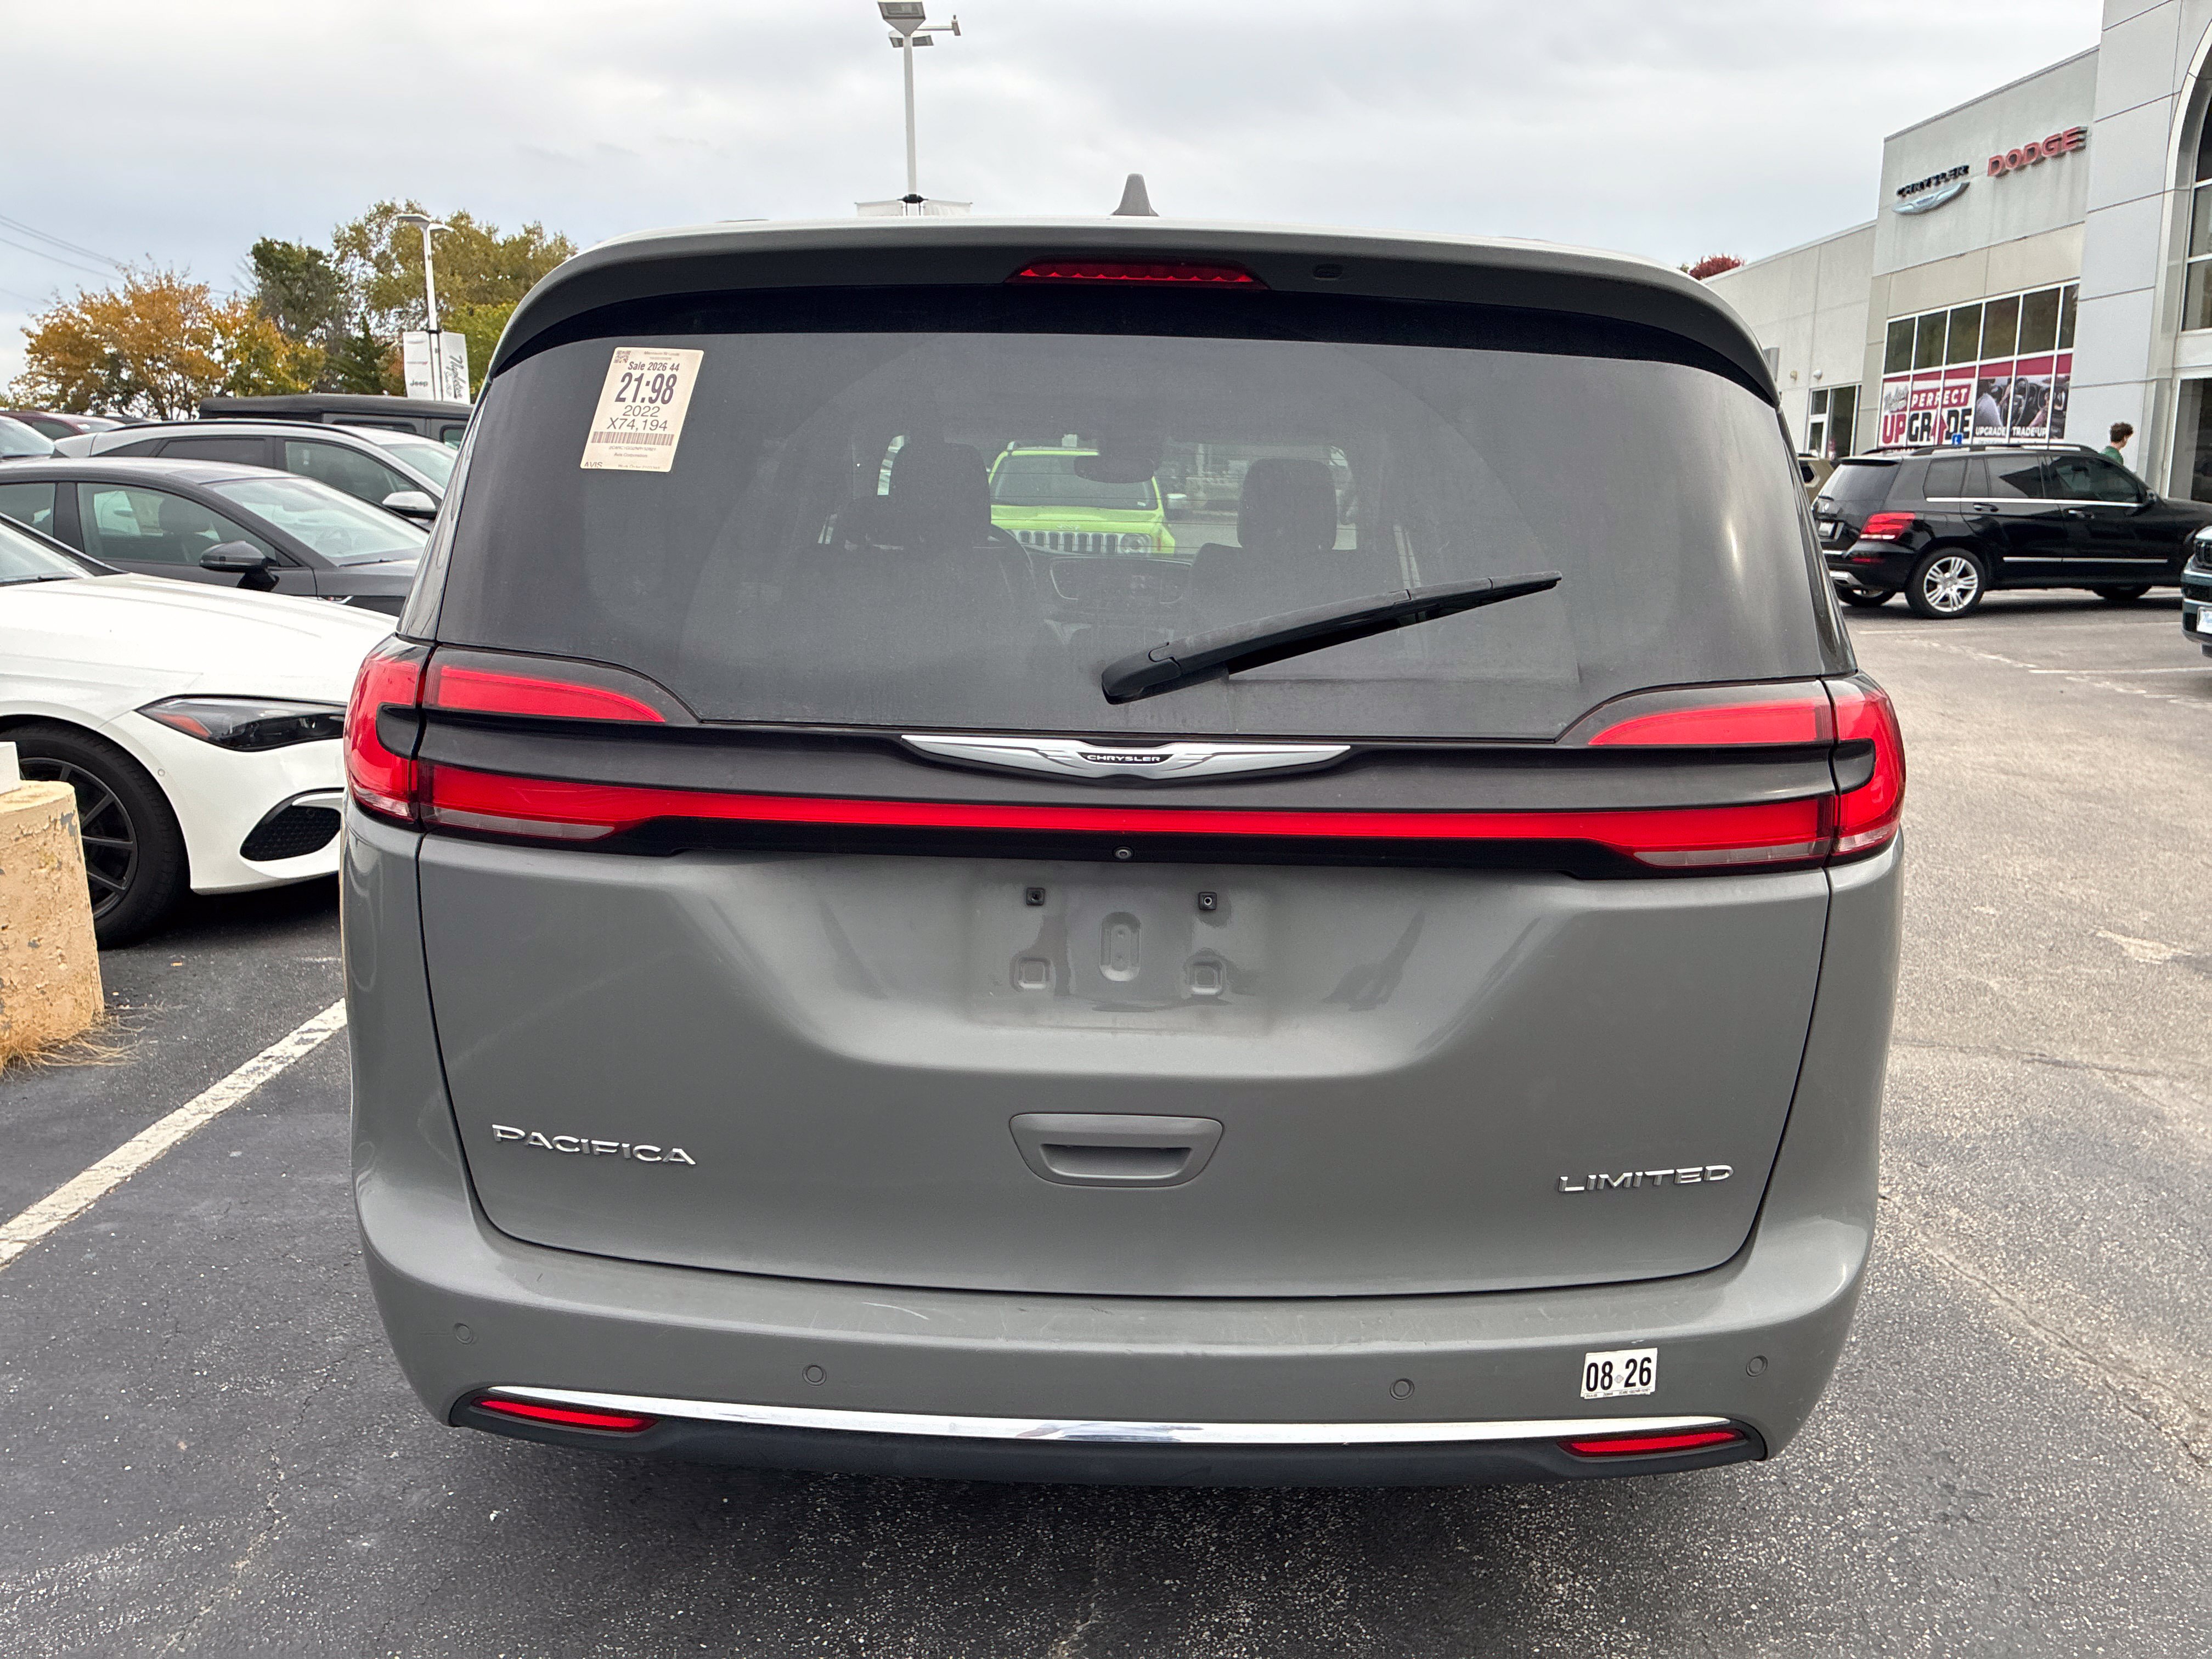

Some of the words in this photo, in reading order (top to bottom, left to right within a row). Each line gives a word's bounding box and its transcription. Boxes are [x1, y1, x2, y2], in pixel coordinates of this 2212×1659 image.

[1987, 126, 2087, 176] DODGE
[628, 362, 645, 371] Sale
[647, 362, 667, 371] 2026
[669, 363, 680, 371] 44
[614, 372, 678, 405] 21:98
[1911, 388, 1968, 408] PERFECT
[607, 417, 668, 432] X74,194
[623, 405, 661, 417] 2022
[492, 1124, 696, 1165] PACIFICA
[1558, 1165, 1734, 1192] LIMITED
[1586, 1361, 1613, 1392] 08
[1624, 1357, 1651, 1387] 26
